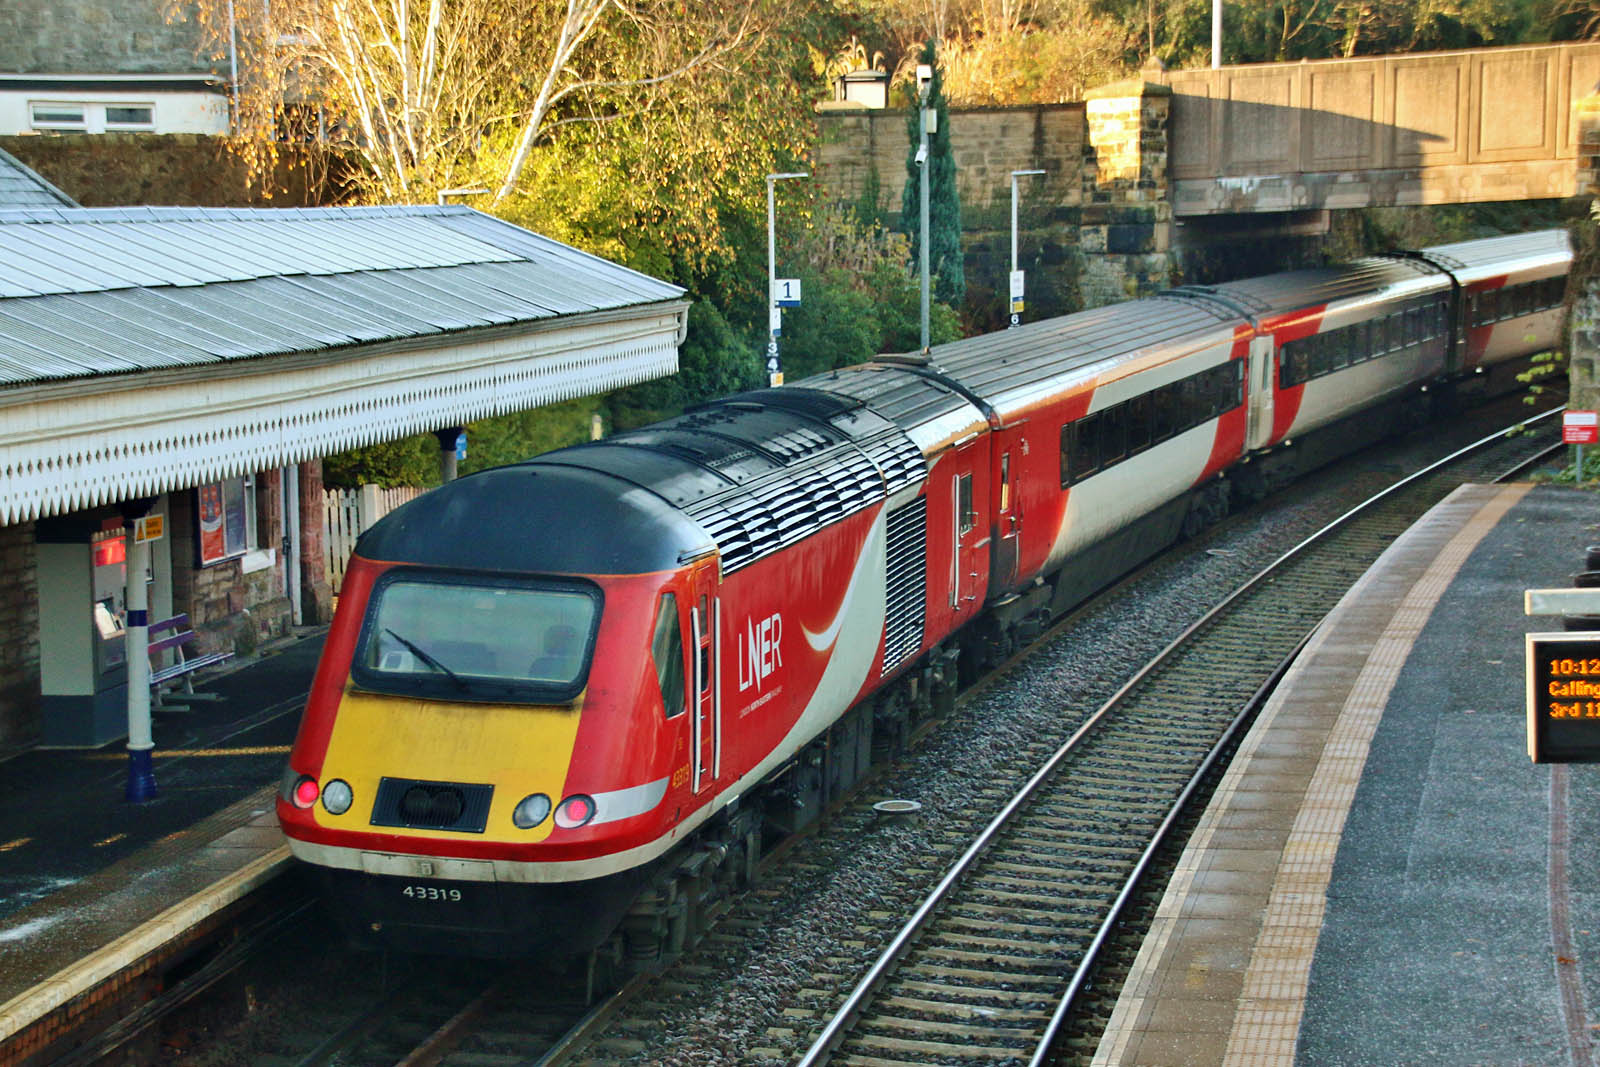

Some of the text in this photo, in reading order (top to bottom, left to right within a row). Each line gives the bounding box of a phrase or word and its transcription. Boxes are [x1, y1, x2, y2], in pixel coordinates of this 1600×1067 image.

[783, 282, 792, 298] 1
[1011, 314, 1019, 324] 6
[767, 343, 777, 353] 3
[739, 612, 783, 693] LNER
[1550, 658, 1600, 676] 10:12
[1548, 680, 1600, 699] Calling
[1549, 701, 1582, 719] 3rd
[402, 886, 462, 902] 43319
